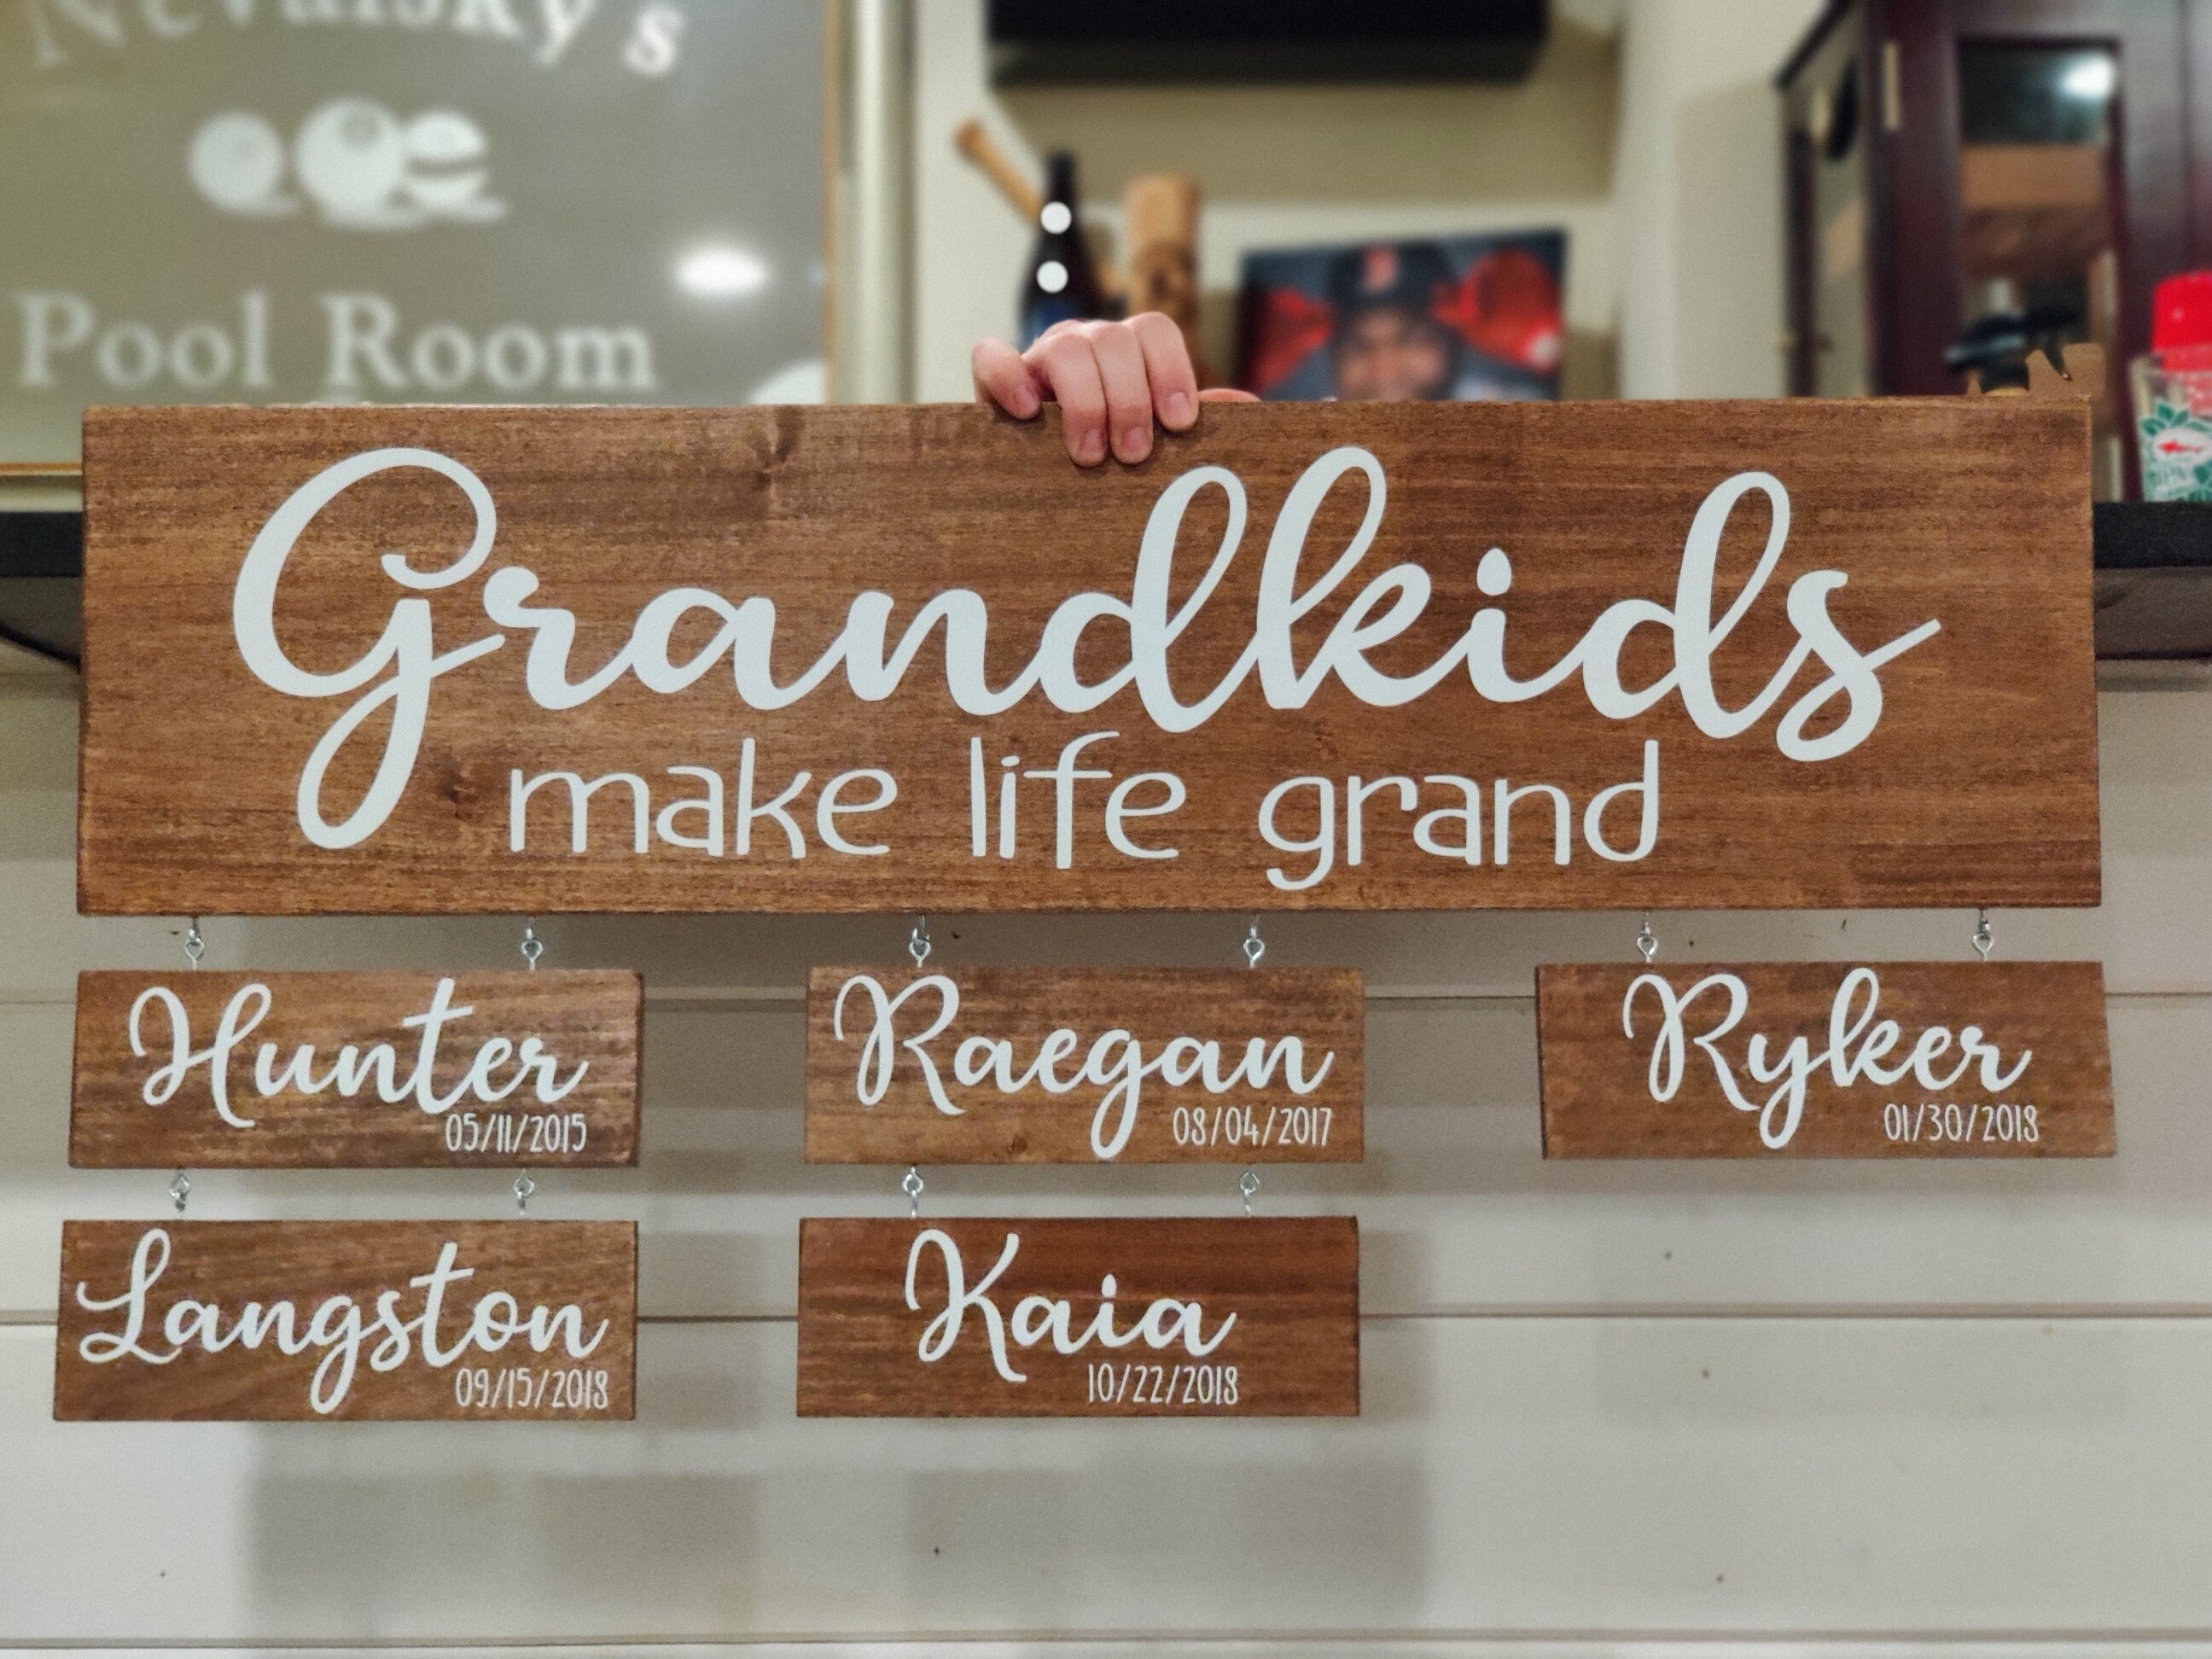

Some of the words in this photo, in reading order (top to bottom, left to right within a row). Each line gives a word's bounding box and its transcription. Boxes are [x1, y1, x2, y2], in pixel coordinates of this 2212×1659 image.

[14, 290, 271, 390] Pool
[318, 290, 657, 392] Room
[231, 445, 1942, 850] Grandkids
[509, 736, 899, 860] make
[969, 730, 1187, 870] life
[1257, 738, 1660, 892] grand
[127, 975, 591, 1129] Hunter
[832, 974, 1336, 1161] Raegan
[1173, 1106, 1333, 1146] 08/04/2017
[1621, 966, 2034, 1150] Ryker
[1883, 1103, 2040, 1143] 01/30/2018
[445, 1112, 588, 1154] 05/11/2015
[74, 1227, 610, 1416] Langston
[904, 1227, 1237, 1383] Kaia
[455, 1367, 609, 1410] 09/15/2018
[1088, 1363, 1239, 1406] 10/22/2018
